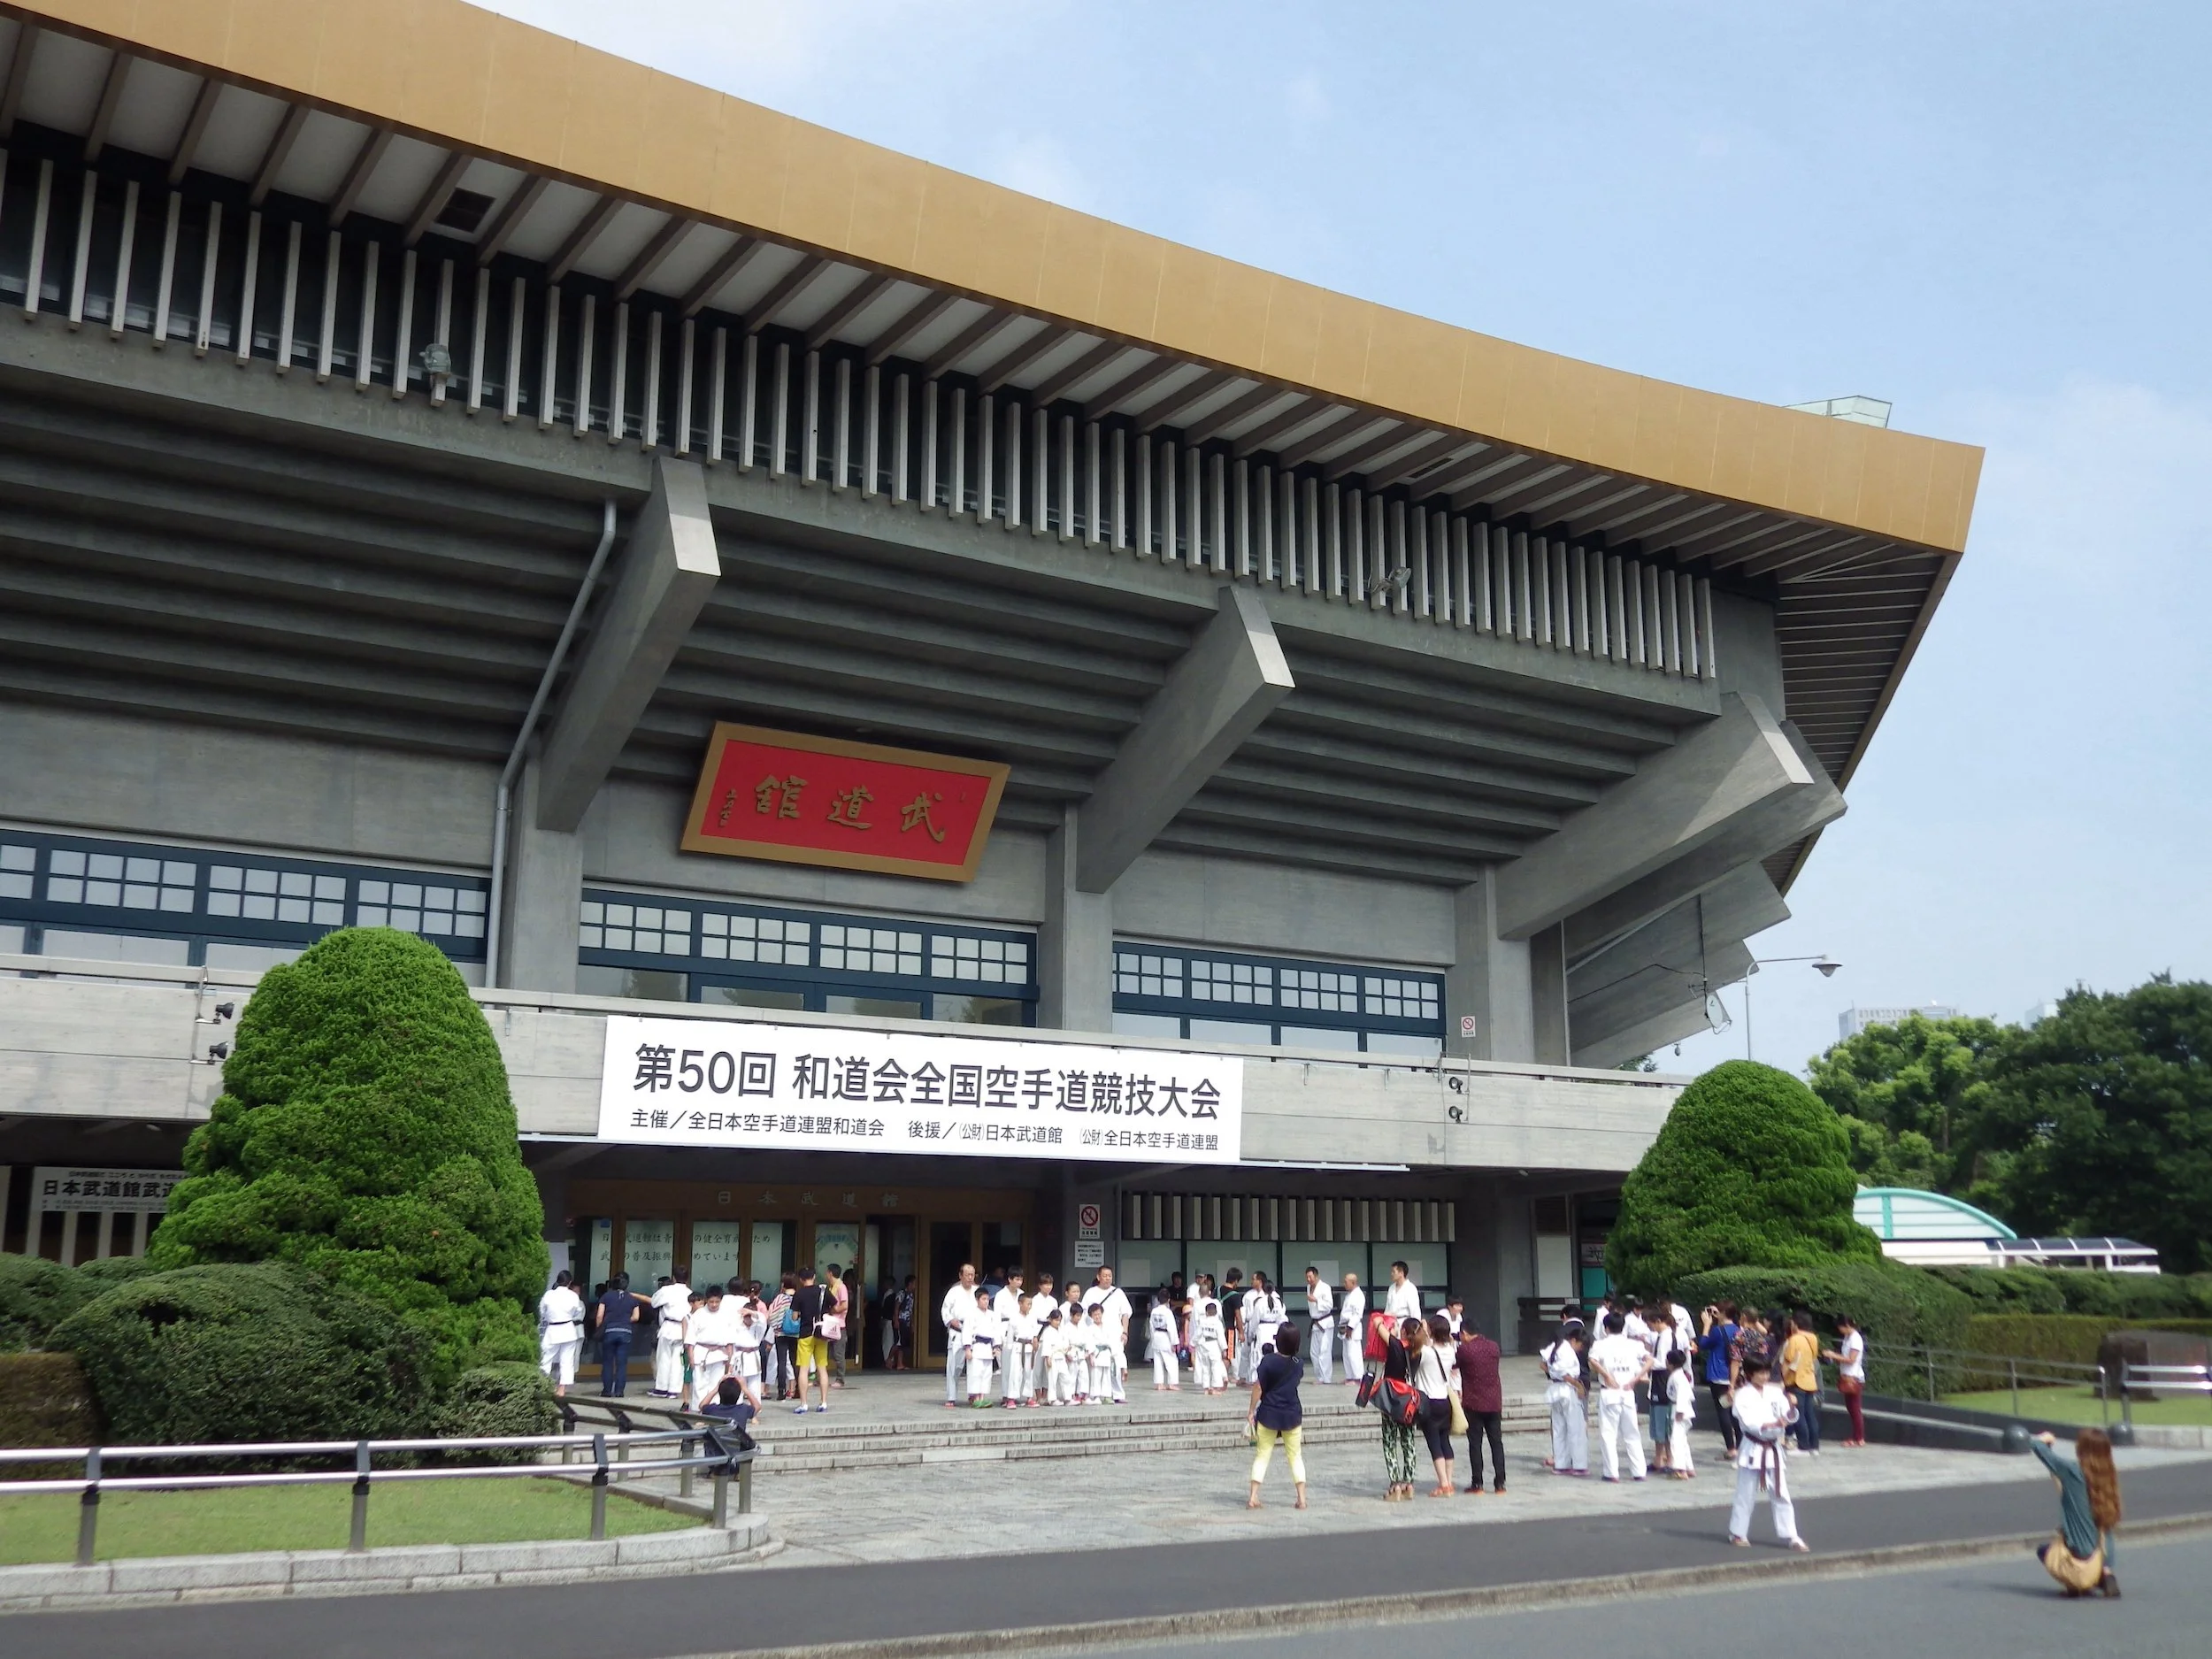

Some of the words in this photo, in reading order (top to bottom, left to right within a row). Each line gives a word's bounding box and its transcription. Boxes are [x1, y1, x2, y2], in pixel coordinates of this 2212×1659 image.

[755, 773, 945, 843] 武道館
[633, 1042, 777, 1098] 第50回
[792, 1053, 1221, 1120] 和道会全国空手道競技大会
